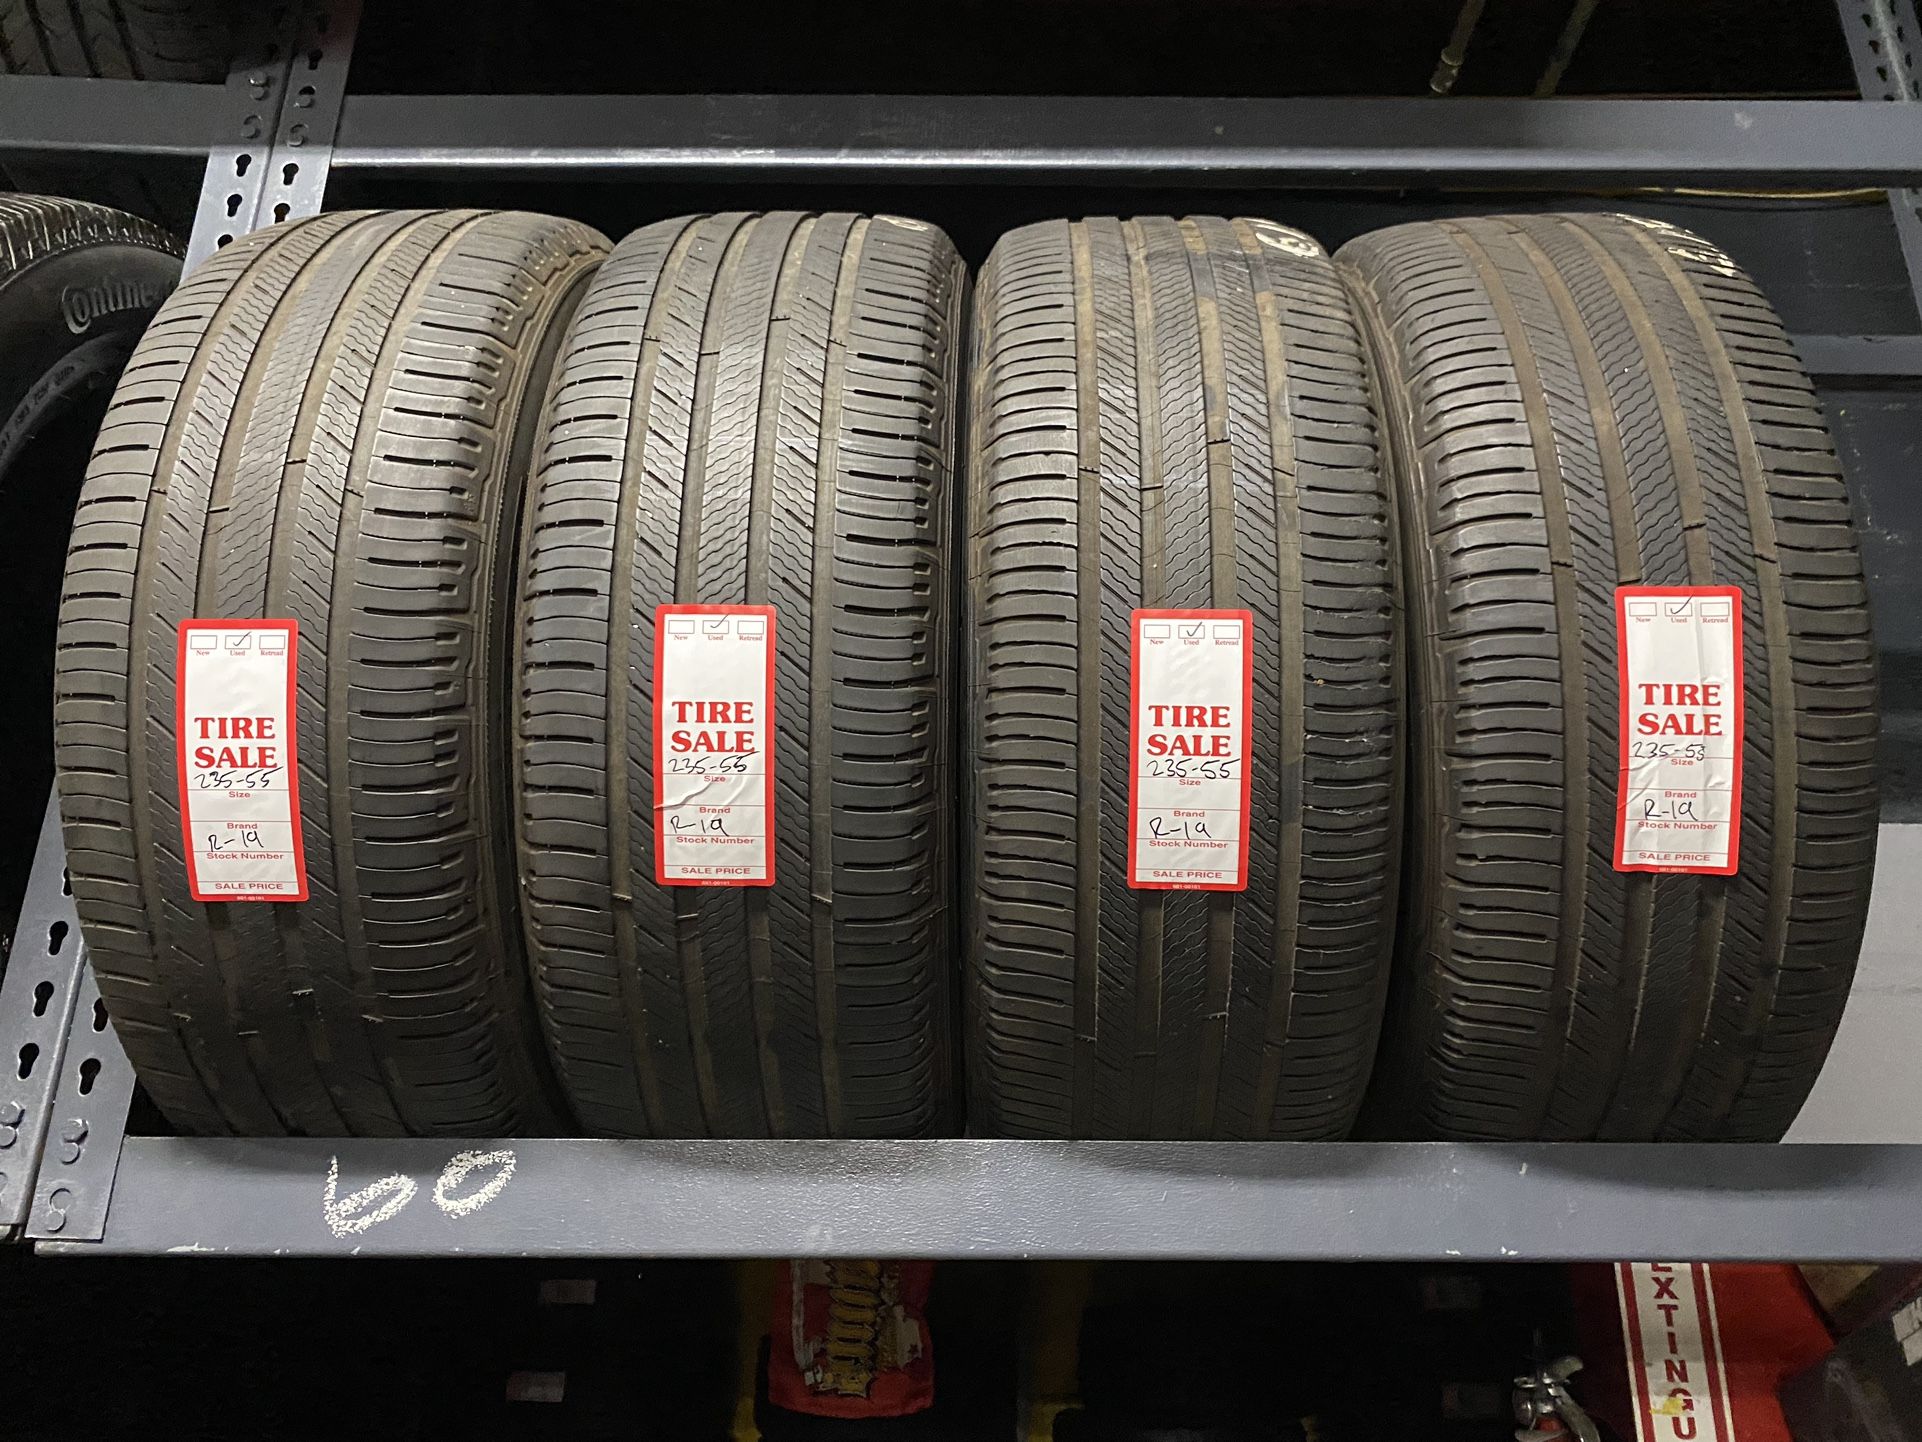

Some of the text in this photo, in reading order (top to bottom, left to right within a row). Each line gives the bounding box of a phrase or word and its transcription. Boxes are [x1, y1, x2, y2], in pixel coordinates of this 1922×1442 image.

[1638, 683, 1721, 707] TIRE
[671, 701, 754, 724] TIRE
[1148, 705, 1231, 728] TIRE
[194, 717, 276, 739] TIRE
[1637, 713, 1722, 736] SALE
[670, 730, 755, 753] SALE
[1146, 734, 1232, 757] SALE
[194, 746, 277, 769] SALE
[668, 751, 760, 775] 235-55
[1146, 758, 1240, 779] 235-55
[193, 766, 284, 789] 235-55
[703, 775, 727, 783] Size
[1638, 821, 1718, 830] Stock Number
[1183, 841, 1228, 849] Number
[1638, 852, 1671, 860] SALE
[715, 867, 751, 875] PRICE
[1187, 871, 1223, 879] PRICE
[1651, 1263, 1697, 1440] XTINGU
